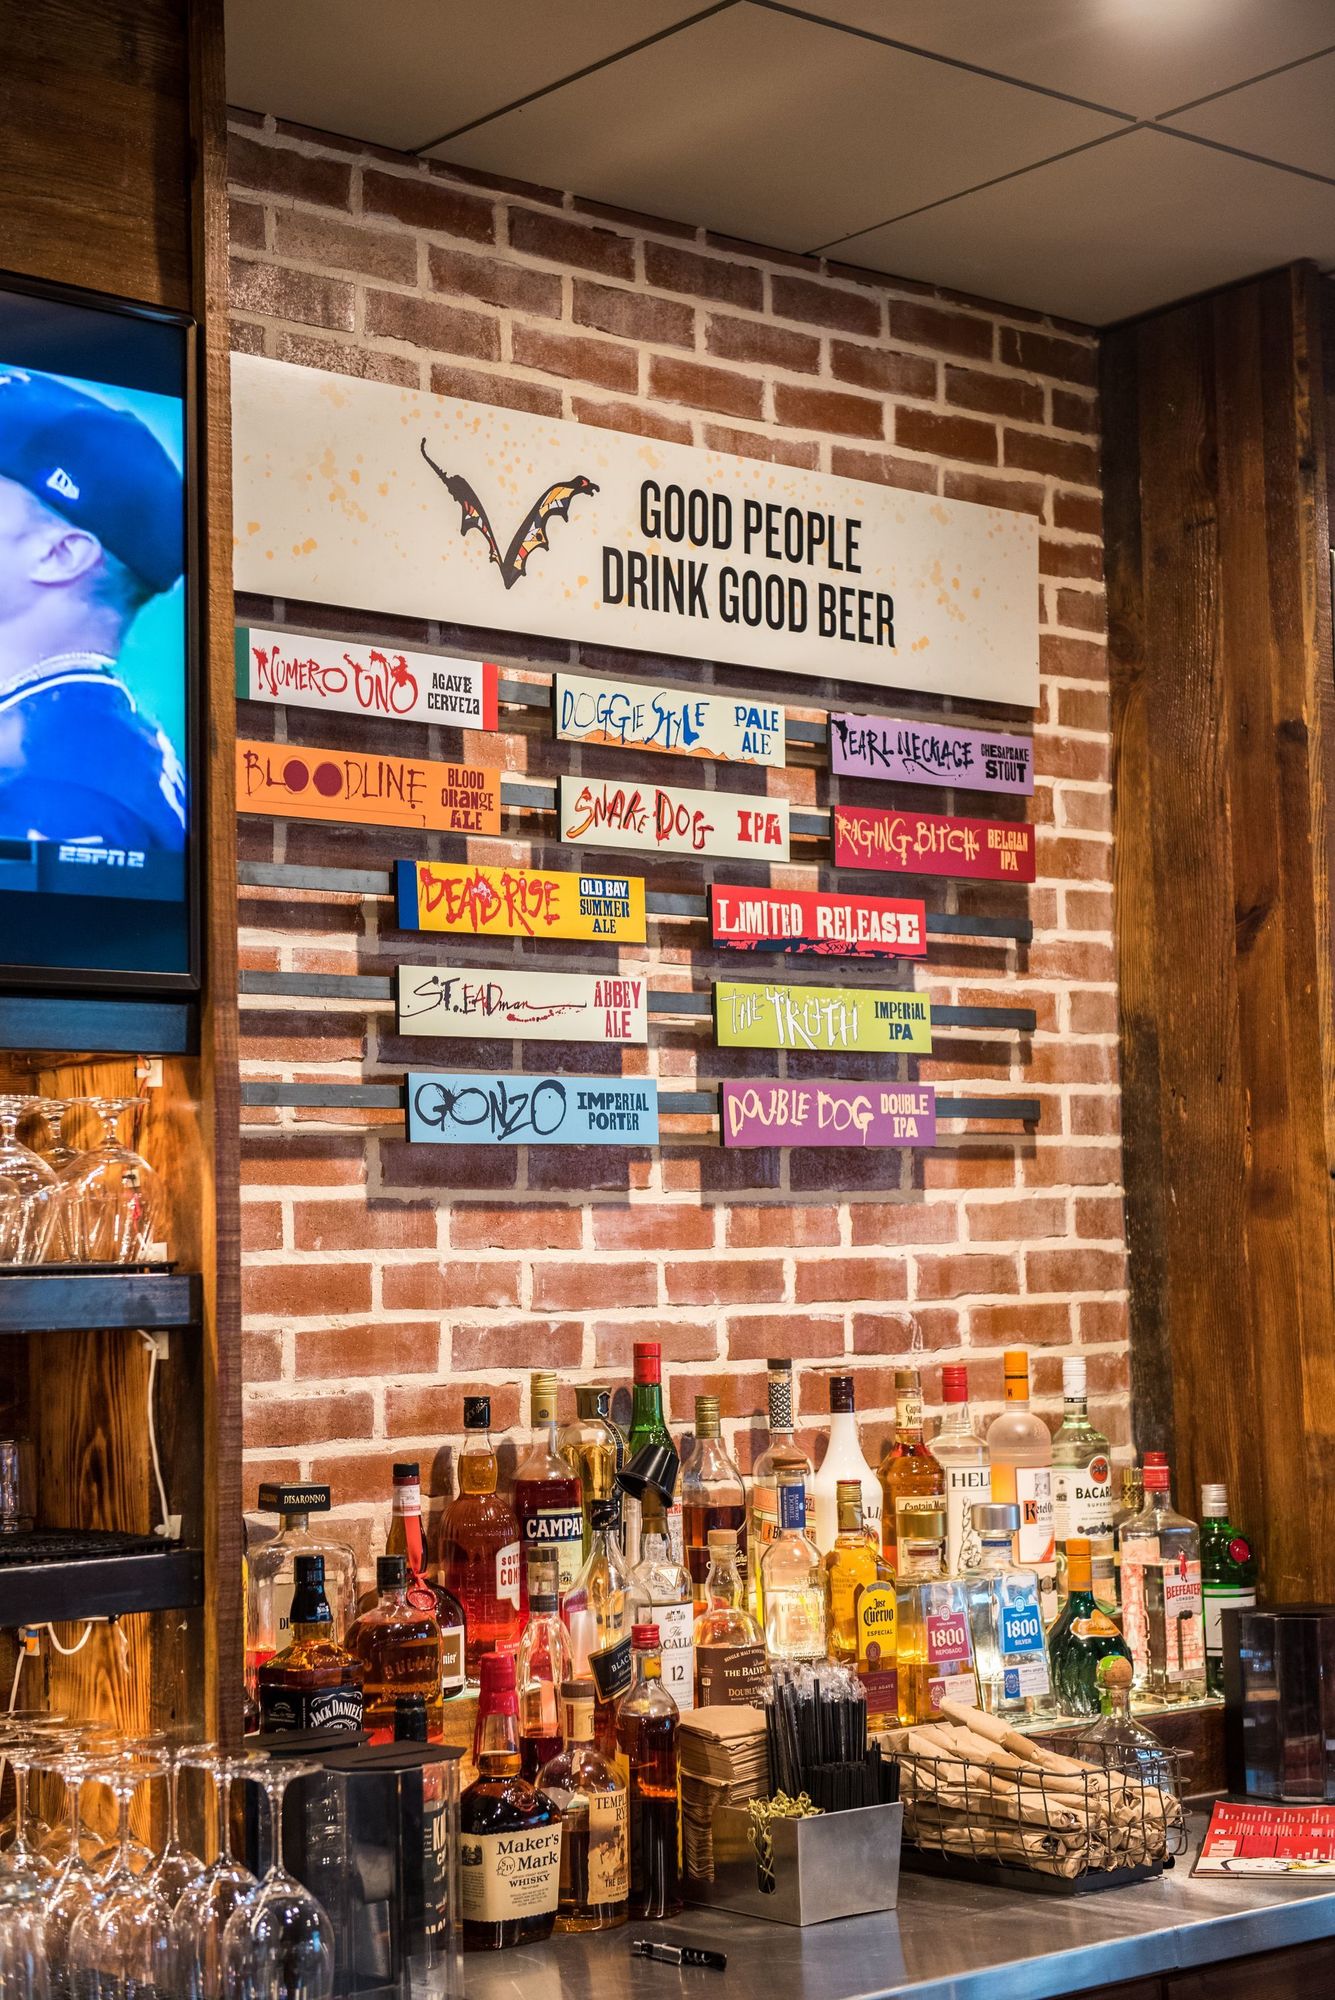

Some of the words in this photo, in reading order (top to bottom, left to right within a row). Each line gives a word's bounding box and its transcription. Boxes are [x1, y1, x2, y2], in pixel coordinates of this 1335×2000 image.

[640, 479, 733, 550] GOOD
[743, 498, 862, 574] PEOPLE
[602, 545, 709, 619] DRINK
[719, 566, 808, 633] GOOD
[818, 582, 896, 648] BEER
[252, 646, 348, 697] NUMERO
[343, 649, 419, 714] UNO
[432, 672, 473, 694] AGAVE
[561, 690, 645, 744] DOGGIE
[734, 706, 779, 732] PALE
[741, 731, 772, 755] ALE
[831, 719, 895, 767] PEARL
[898, 731, 975, 770] NECKLACE
[980, 743, 1030, 762] CHESAPEAKE
[243, 750, 427, 809] BLOODLINE
[447, 768, 485, 790] BLOOD
[985, 760, 1027, 783] STOUT
[450, 810, 482, 831] ALE
[566, 784, 650, 839] SNAKE
[653, 789, 715, 850] DOG
[737, 810, 782, 845] IPA
[835, 815, 913, 866] RAGING
[913, 821, 980, 861] BITCH
[987, 829, 1029, 852] BELGIAN
[1000, 851, 1019, 871] IPA
[580, 879, 603, 896] OLD
[419, 867, 501, 932] DEAD
[580, 898, 630, 918] SUMMER
[592, 919, 617, 934] ALE
[717, 899, 803, 937] LIMITED
[816, 906, 921, 944] RELEASE
[593, 979, 642, 1009] ABBEY
[605, 1009, 632, 1038] ALE
[720, 988, 764, 1034] THE
[765, 987, 858, 1049] TRUTH
[888, 1023, 914, 1040] IPA
[414, 1079, 567, 1141] GONZO
[576, 1091, 650, 1112] IMPERIAL
[880, 1093, 930, 1115] DOUBLE
[588, 1112, 640, 1131] PORTER
[728, 1088, 812, 1137] DOUBLE
[817, 1089, 875, 1143] DOG
[893, 1117, 919, 1138] IPA
[283, 1494, 326, 1504] DISARONNO
[1075, 1486, 1112, 1499] BACAR
[526, 1516, 583, 1539] CAMPA
[1166, 1583, 1201, 1600] BEEFEATER
[863, 1606, 894, 1627] Cuervo
[867, 1628, 893, 1637] ESPECIAL
[930, 1627, 965, 1648] 1800
[1005, 1618, 1039, 1639] 1800
[659, 1635, 693, 1650] ACALLA
[935, 1647, 963, 1657] REPOSADO
[1014, 1638, 1032, 1646] SILVER
[443, 1653, 457, 1664] nier
[611, 1653, 632, 1672] BLAC
[671, 1666, 685, 1681] 12
[309, 1703, 332, 1727] JACK
[332, 1699, 363, 1722] DANIEL'S
[595, 1793, 627, 1809] TEMPL
[496, 1834, 559, 1855] Maker's
[517, 1851, 558, 1871] Mark
[509, 1873, 550, 1888] WHISKY
